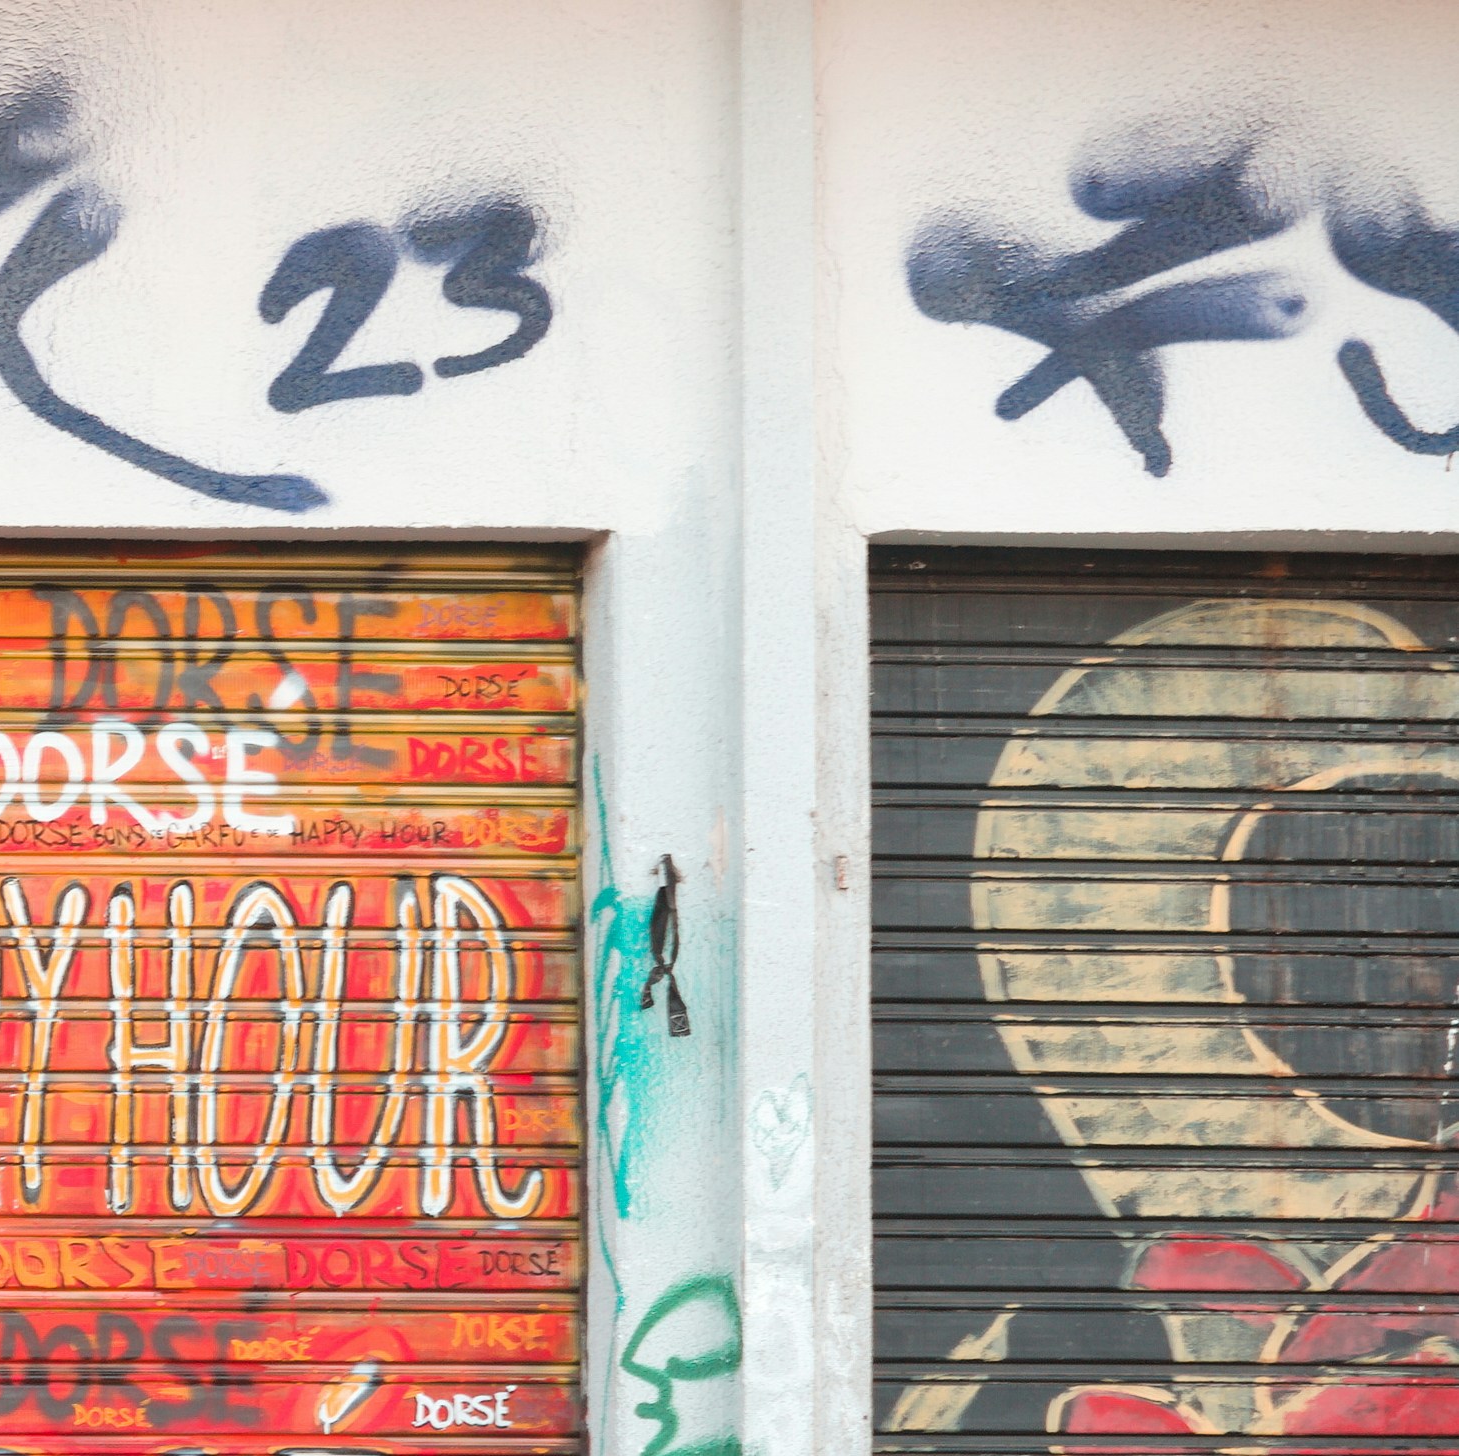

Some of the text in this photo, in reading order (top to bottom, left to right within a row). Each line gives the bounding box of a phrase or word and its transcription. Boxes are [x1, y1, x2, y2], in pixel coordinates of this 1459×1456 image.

[290, 817, 366, 849] HAPPY
[381, 819, 453, 846] HOUR
[104, 872, 545, 1219] HOUR
